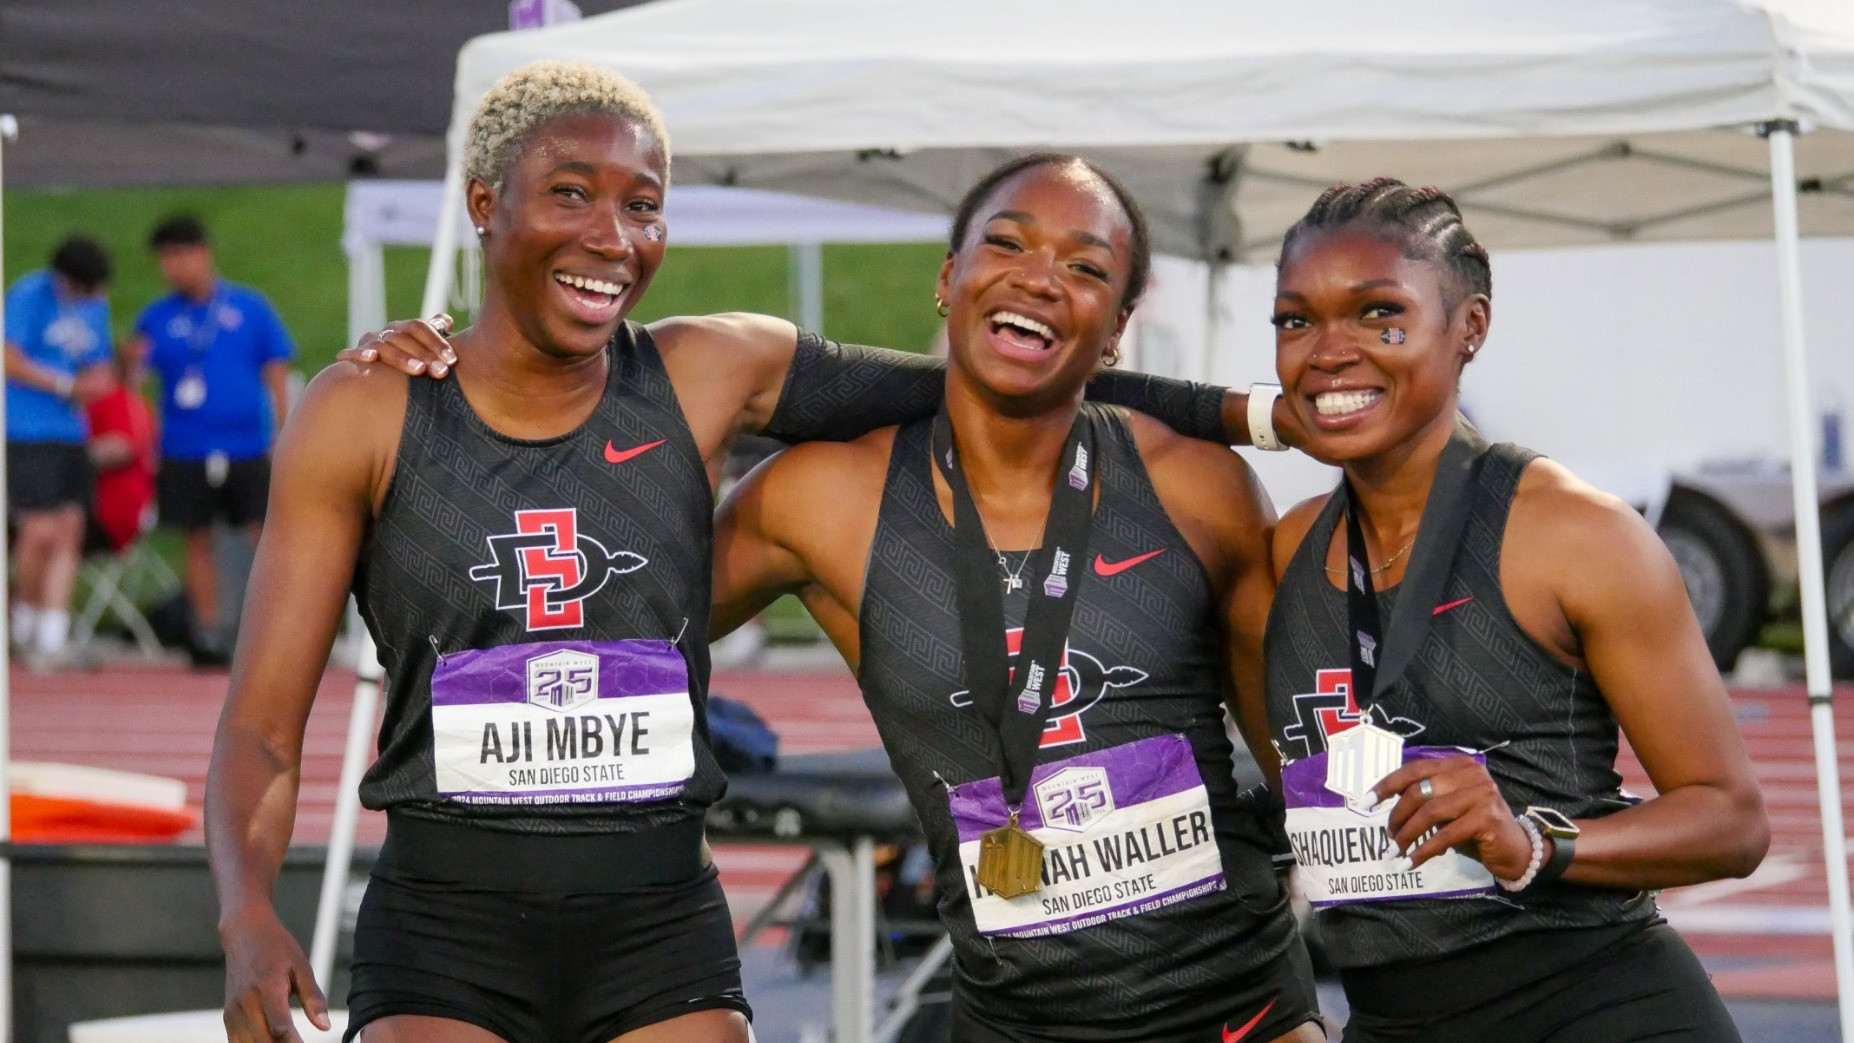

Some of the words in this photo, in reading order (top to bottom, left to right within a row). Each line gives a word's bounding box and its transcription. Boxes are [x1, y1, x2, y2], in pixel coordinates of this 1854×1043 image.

[1057, 551, 1070, 575] WEST
[534, 667, 593, 696] 25
[1031, 665, 1045, 690] WEST
[480, 721, 533, 764] AJI
[546, 712, 650, 761] MBYE
[509, 769, 536, 786] SAN
[540, 767, 579, 784] DIEGO
[583, 764, 625, 782] STATE
[472, 796, 510, 805] MOUNTAIN
[511, 796, 532, 805] WEST
[534, 794, 571, 805] OUTDOOR
[571, 793, 596, 803] TRACK
[597, 793, 605, 802] &
[605, 791, 626, 801] FIELD
[628, 784, 685, 800] CHAMPIONSHIPS
[1043, 780, 1107, 820] 25
[1093, 810, 1210, 873] WALLER
[1290, 826, 1390, 867] SHAQUENA
[1042, 894, 1070, 915] SAN
[1072, 885, 1112, 909] DIEGO
[1114, 873, 1157, 899] STATE
[1328, 876, 1348, 894] SAN
[1351, 874, 1384, 892] DIEGO
[1386, 871, 1424, 891] STATE
[1050, 922, 1071, 934] WEST
[1071, 914, 1107, 930] OUTDOOR
[1107, 907, 1132, 920] TRACK
[1133, 906, 1140, 914] &
[1140, 900, 1161, 914] FIELD
